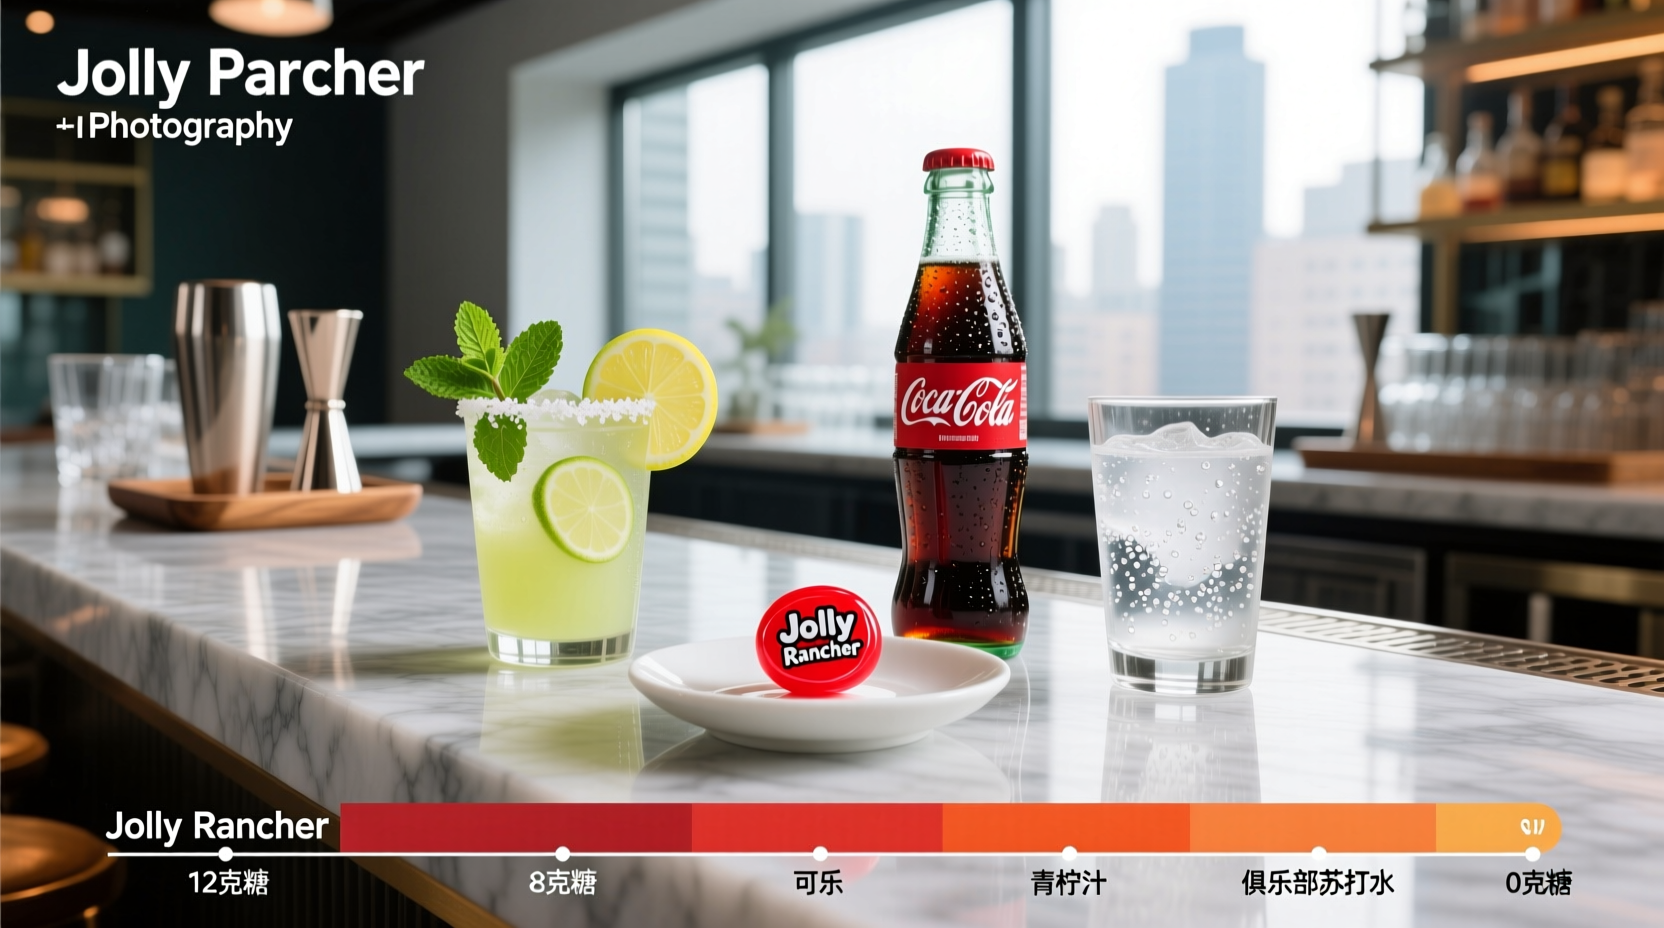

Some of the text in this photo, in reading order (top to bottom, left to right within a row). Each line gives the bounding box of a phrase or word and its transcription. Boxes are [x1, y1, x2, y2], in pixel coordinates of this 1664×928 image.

[901, 377, 1018, 427] Coca-Cola
[779, 608, 855, 644] Jolly
[783, 639, 861, 667] Rancher
